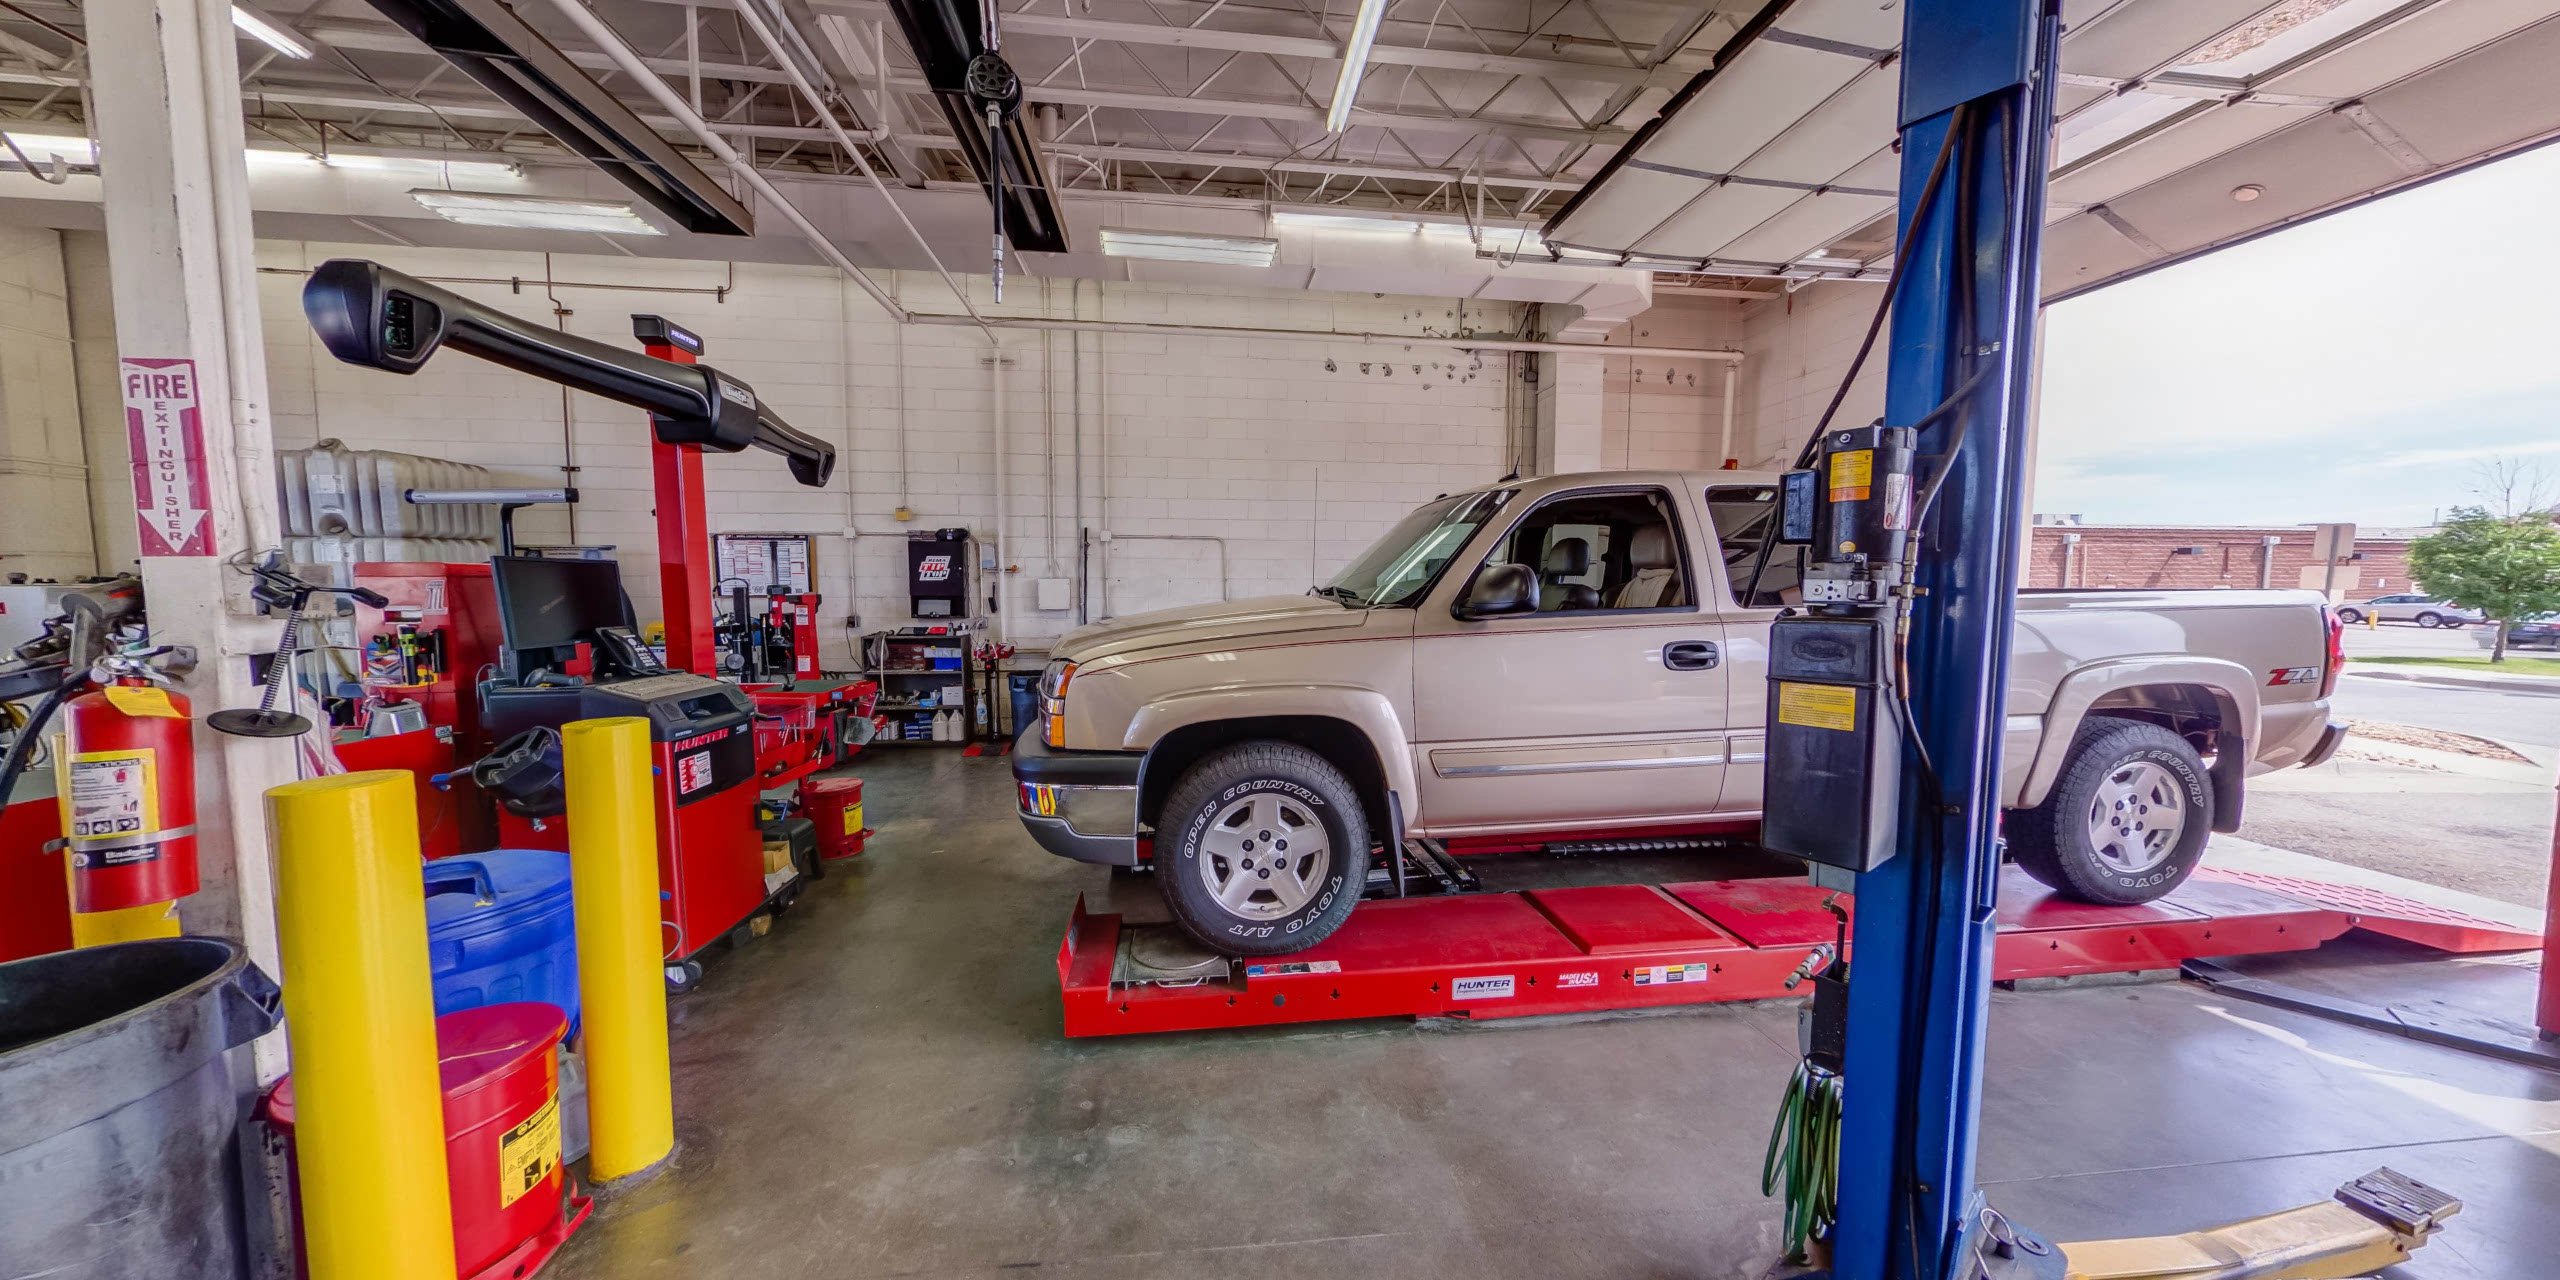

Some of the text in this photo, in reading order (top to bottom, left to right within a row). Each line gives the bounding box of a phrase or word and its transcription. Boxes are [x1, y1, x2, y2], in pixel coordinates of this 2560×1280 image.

[671, 329, 698, 347] HUNTER
[127, 374, 188, 399] FIRE
[154, 401, 183, 541] EXTINGUISHER
[2266, 666, 2318, 686] Z71
[674, 728, 729, 752] HUNTER
[2148, 750, 2204, 807] COUNTRY
[1184, 779, 1324, 858] OPEN COUNTRY
[2119, 865, 2178, 887] TOYO
[1229, 875, 1343, 937] TOYO A/T
[1457, 980, 1511, 989] HUNTER
[1575, 972, 1598, 985] USA
